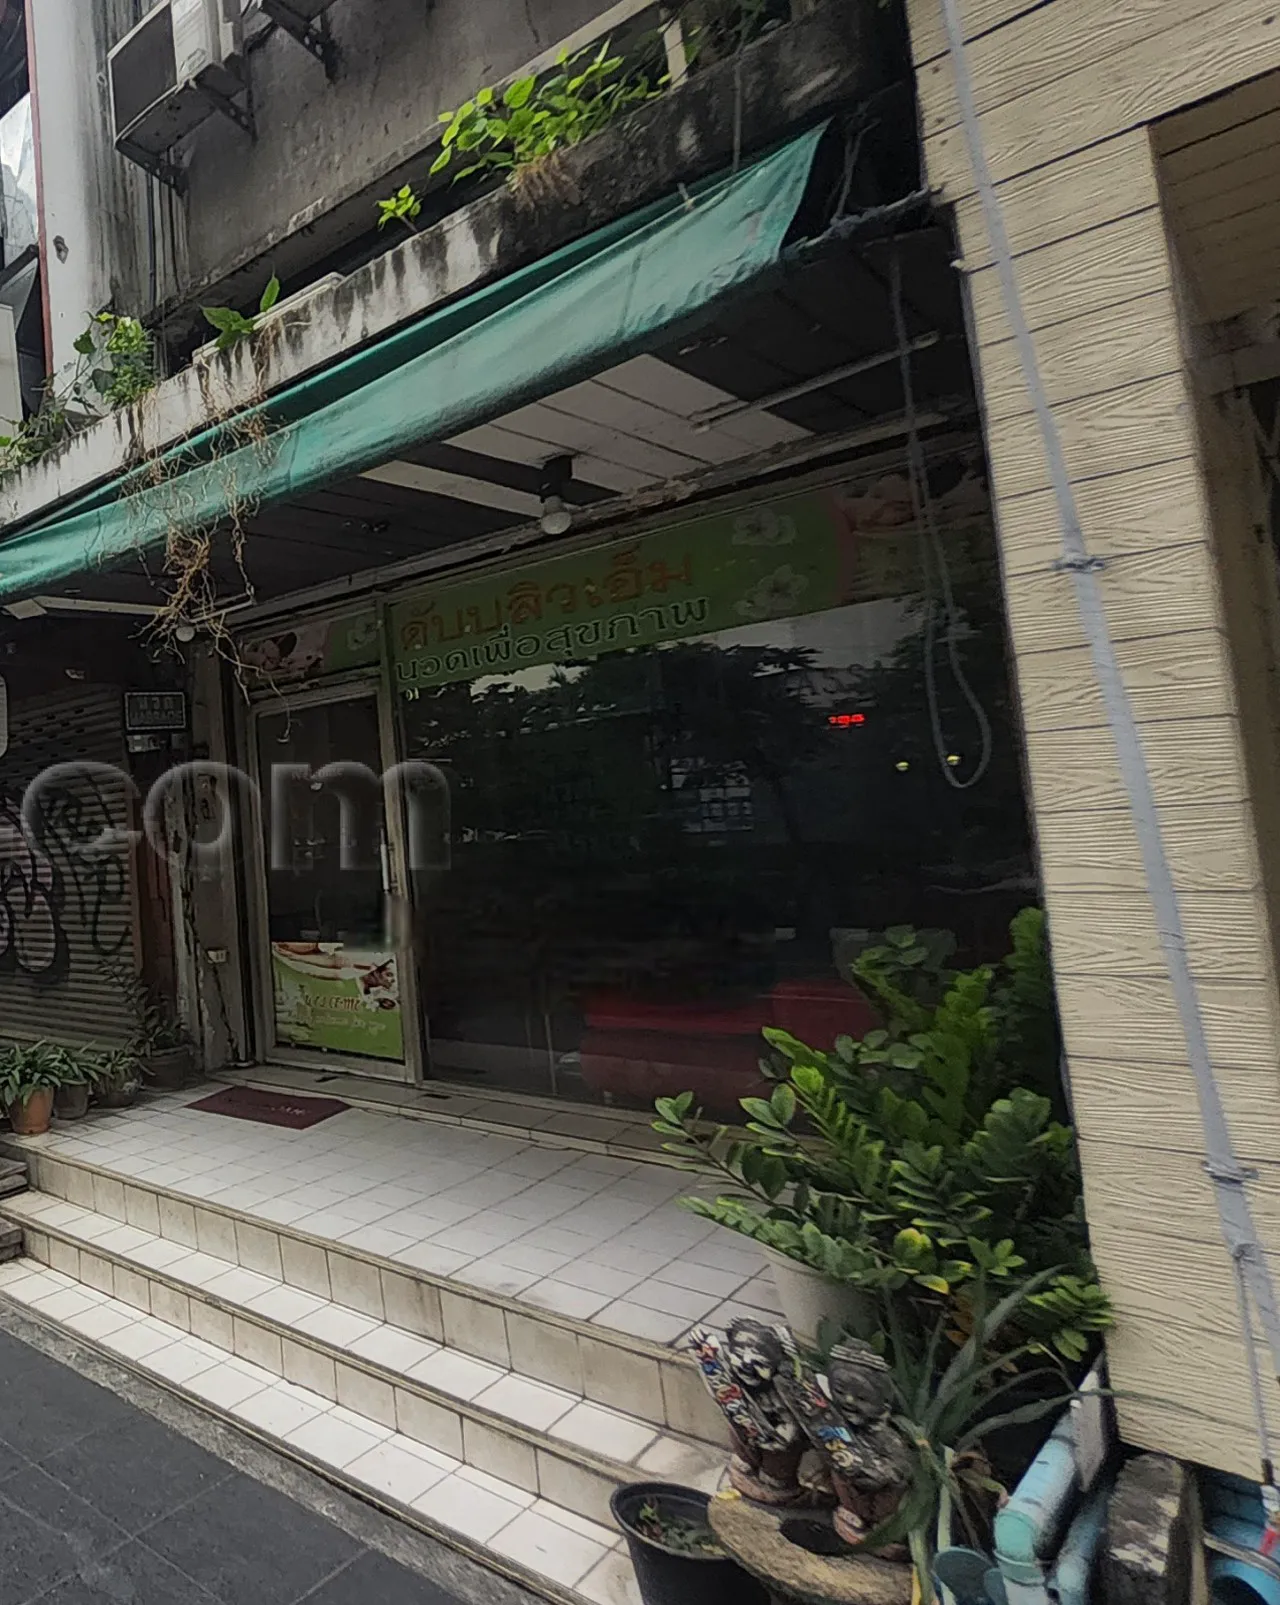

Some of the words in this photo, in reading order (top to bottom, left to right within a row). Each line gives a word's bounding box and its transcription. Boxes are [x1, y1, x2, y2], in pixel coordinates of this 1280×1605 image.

[396, 597, 709, 682] นวดเพื่อสุขภาพ
